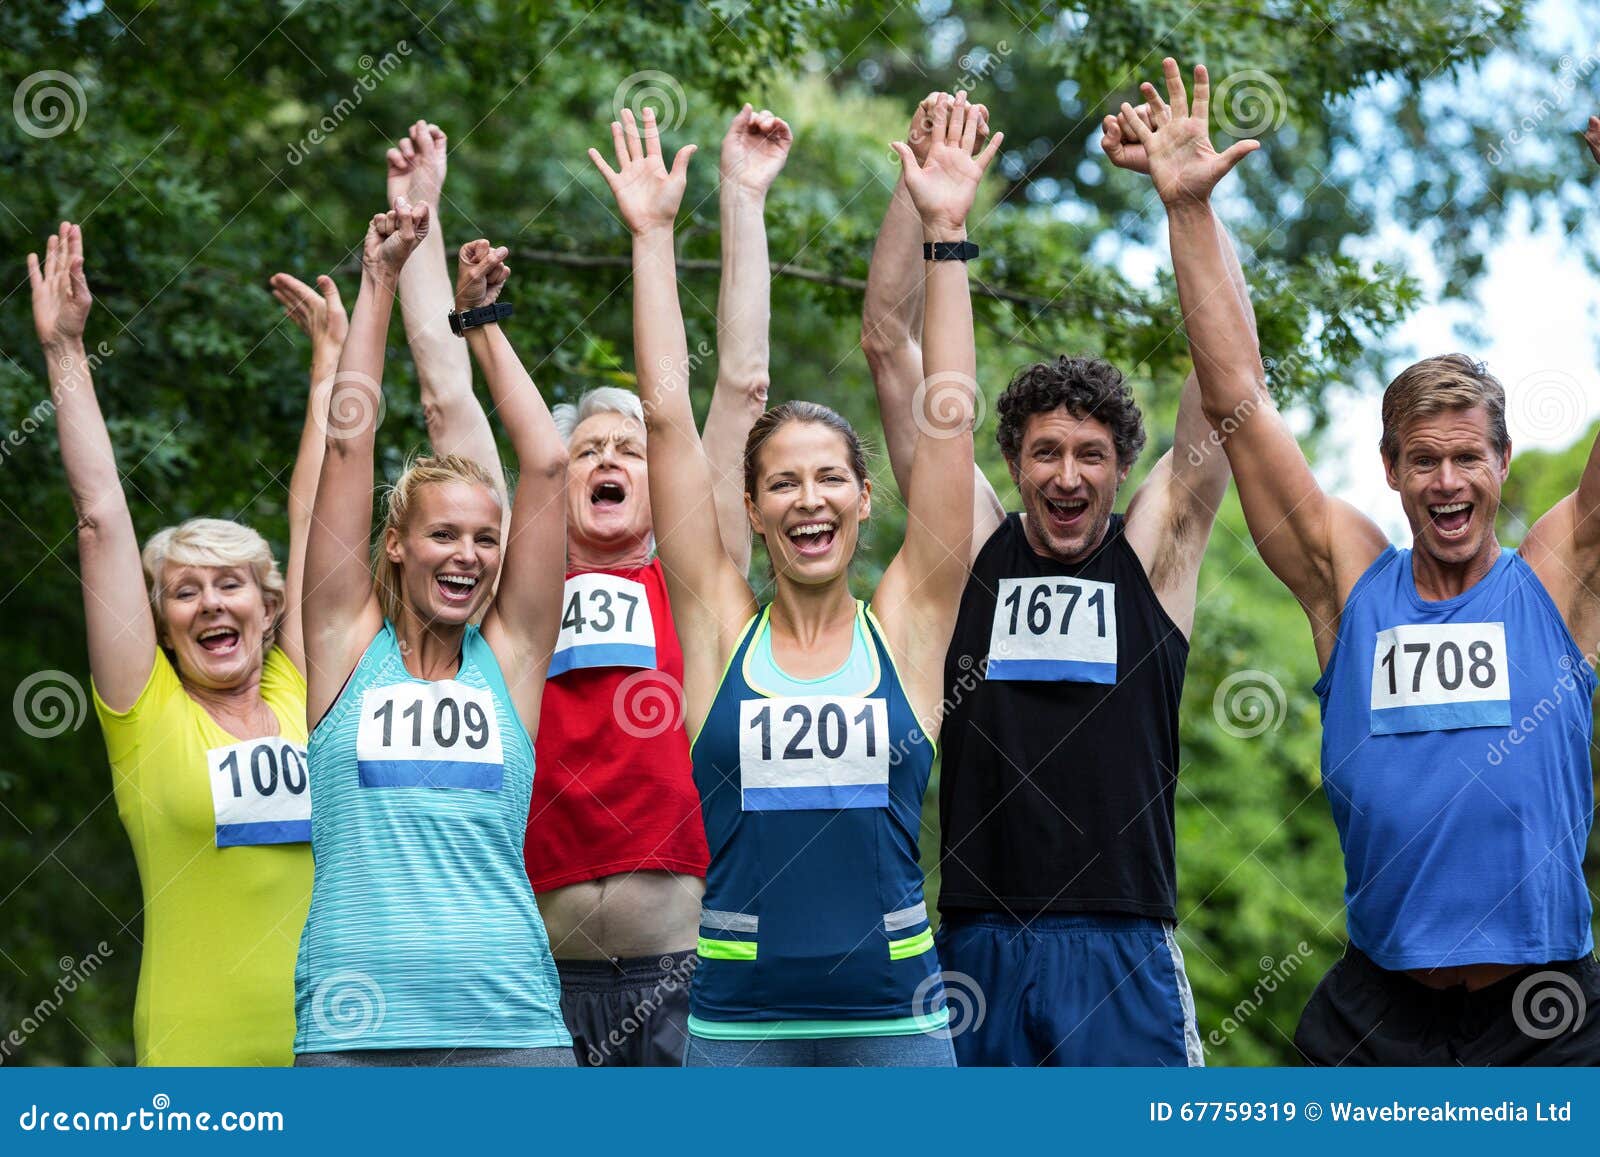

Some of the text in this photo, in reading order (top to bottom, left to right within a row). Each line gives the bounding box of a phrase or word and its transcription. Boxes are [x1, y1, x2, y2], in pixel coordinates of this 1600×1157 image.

[562, 589, 639, 634] 437
[1005, 584, 1106, 638] 1671
[1382, 640, 1496, 694] 1708
[374, 697, 489, 749] 1109
[750, 703, 877, 760] 1201
[219, 744, 307, 797] 100
